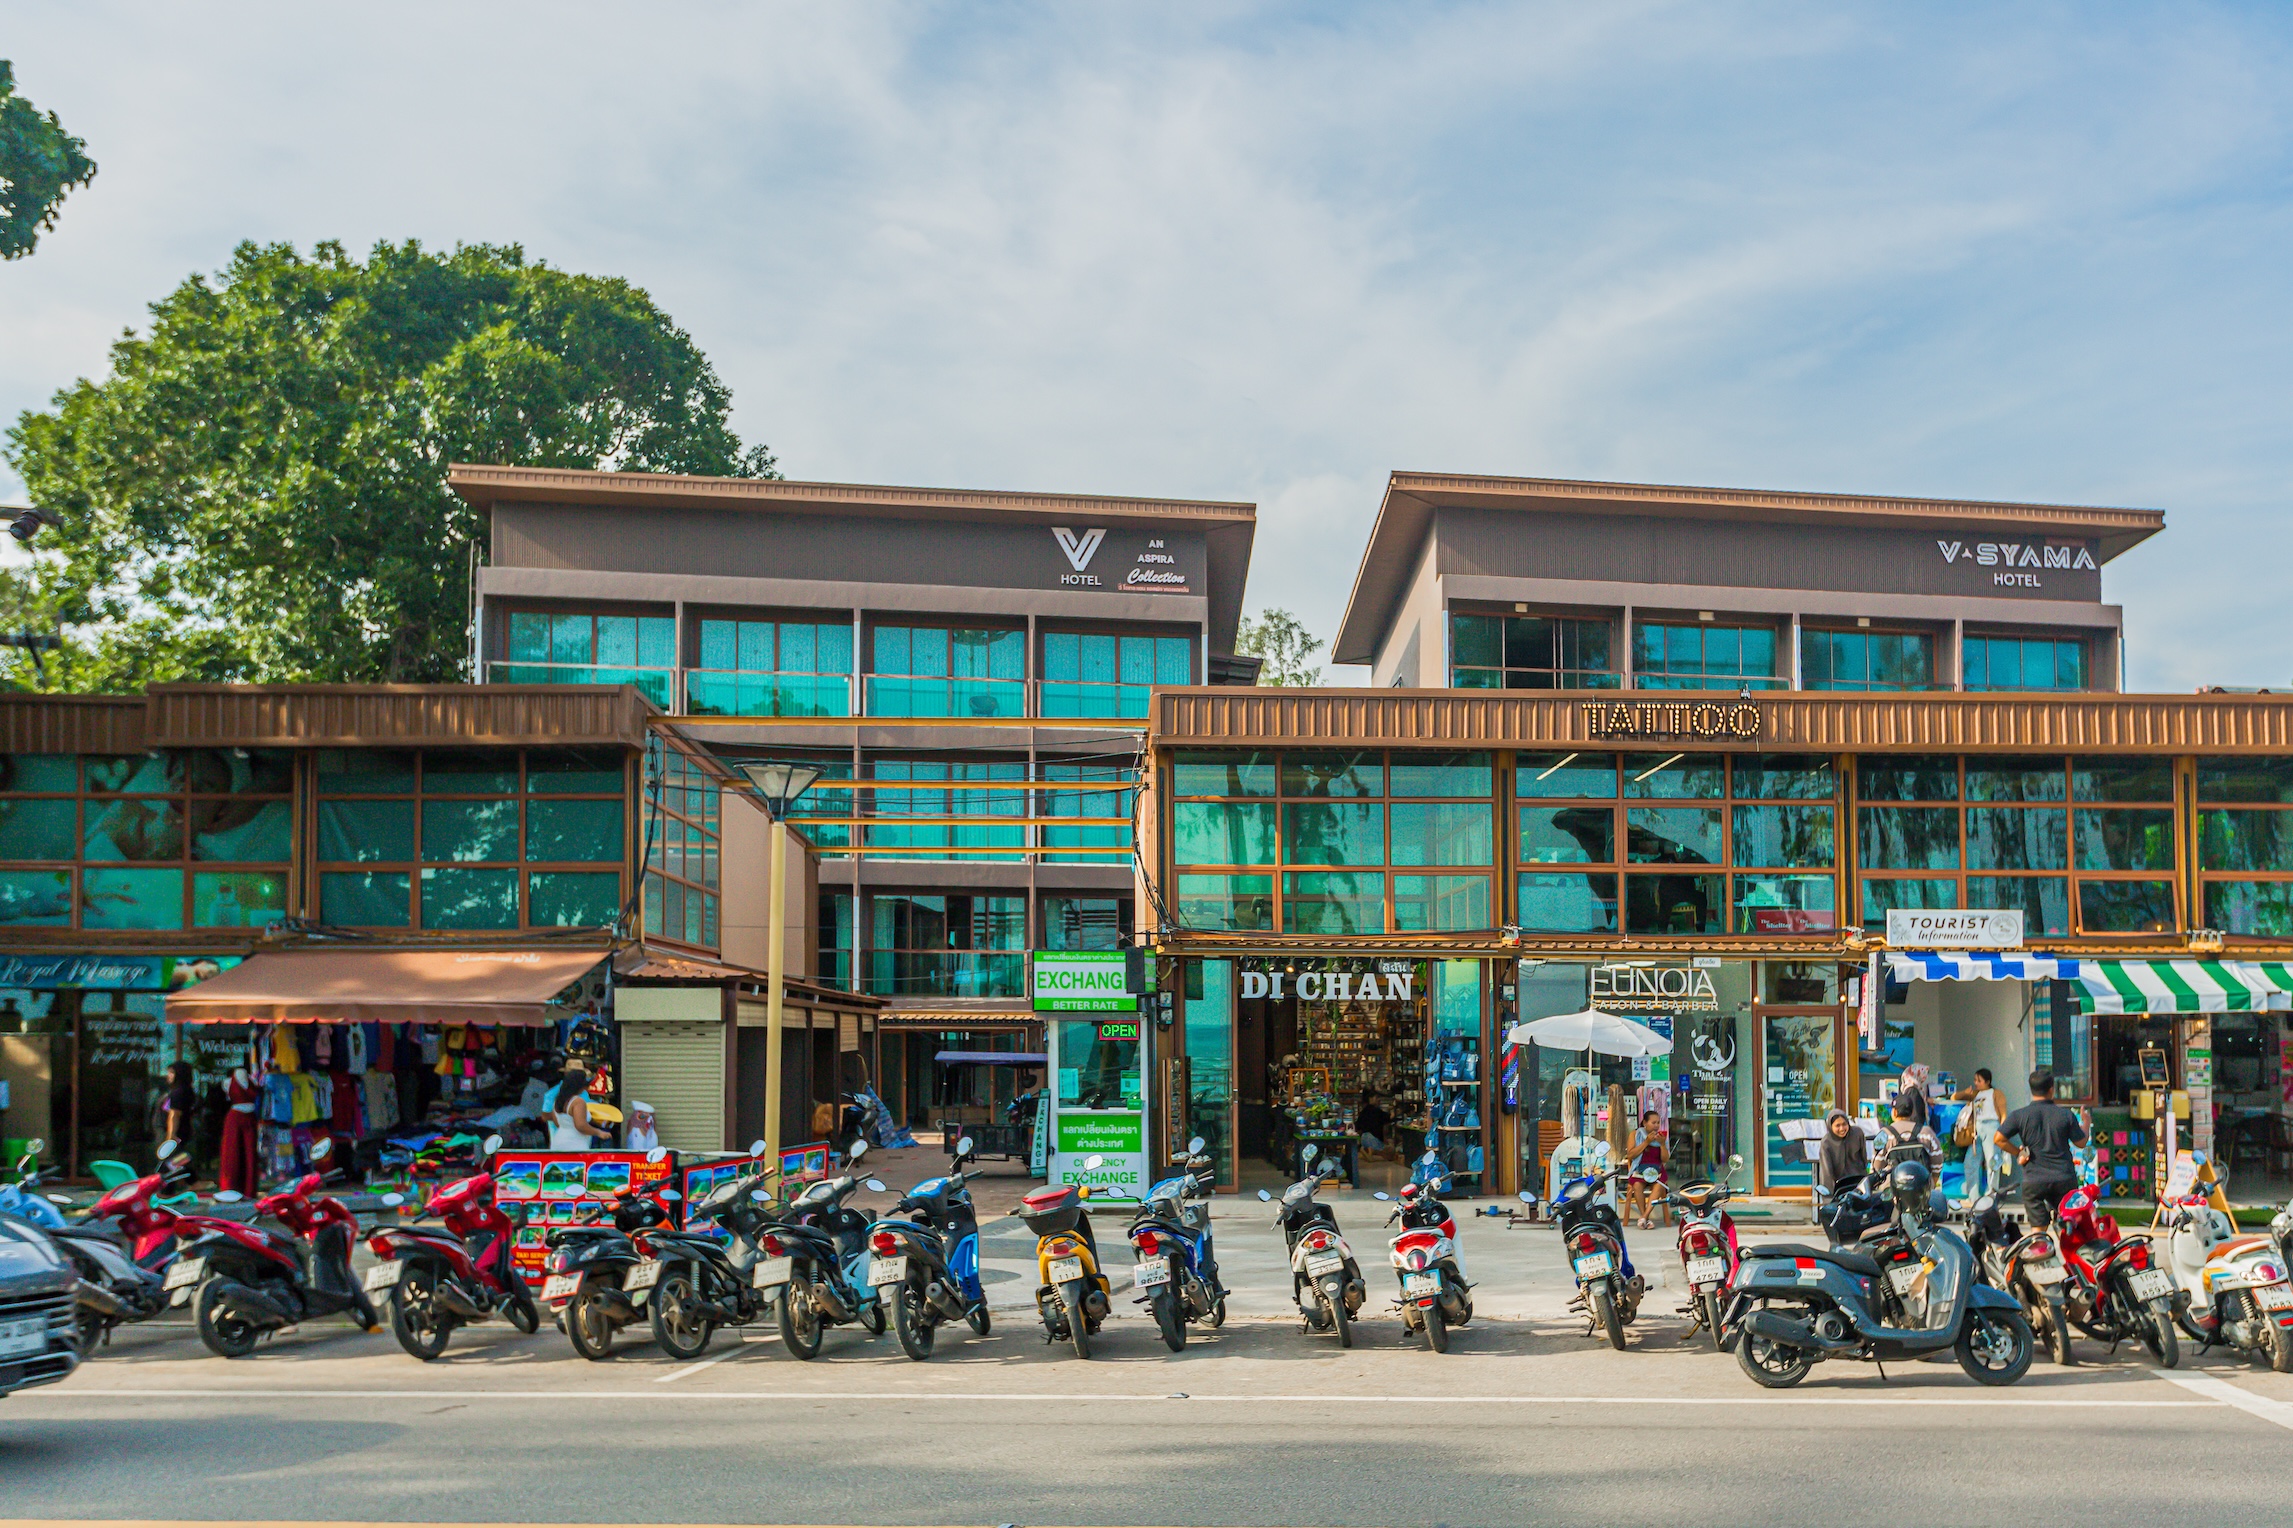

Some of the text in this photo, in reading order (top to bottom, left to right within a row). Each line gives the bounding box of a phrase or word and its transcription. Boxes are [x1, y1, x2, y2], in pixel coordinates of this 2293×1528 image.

[1051, 527, 1107, 572] V
[1149, 539, 1164, 549] AN
[1137, 554, 1175, 564] ASPIRA
[1061, 574, 1102, 586] HOTEL
[1127, 568, 1186, 584] Collection
[1994, 572, 2041, 587] HOTEL
[1582, 703, 1761, 736] TATTOO
[1910, 917, 1990, 929] TOURIST
[1918, 930, 1979, 942] Information
[1037, 971, 1127, 990] EXCHANG
[1241, 972, 1414, 1001] DI CHAN
[1590, 968, 1717, 997] EUNOIA
[1053, 1001, 1118, 1010] BETTER RATE
[1590, 1000, 1719, 1011] SALON & BARBER
[1102, 1025, 1137, 1037] OPEN
[199, 1040, 250, 1053] Welcom
[1692, 1069, 1714, 1078] Thai
[1789, 1071, 1808, 1080] OPEN
[1036, 1100, 1046, 1166] EXCHANGE
[1063, 1121, 1137, 1134] แลกเปลี่ยนเงินตรา
[1077, 1138, 1124, 1148] ต่างประเทศ
[1074, 1159, 1126, 1167] CUENCY
[635, 1173, 662, 1181] TICKET
[1063, 1172, 1138, 1184] EXCHANGE
[875, 1274, 898, 1283] 9256
[1696, 1273, 1718, 1281] 4767
